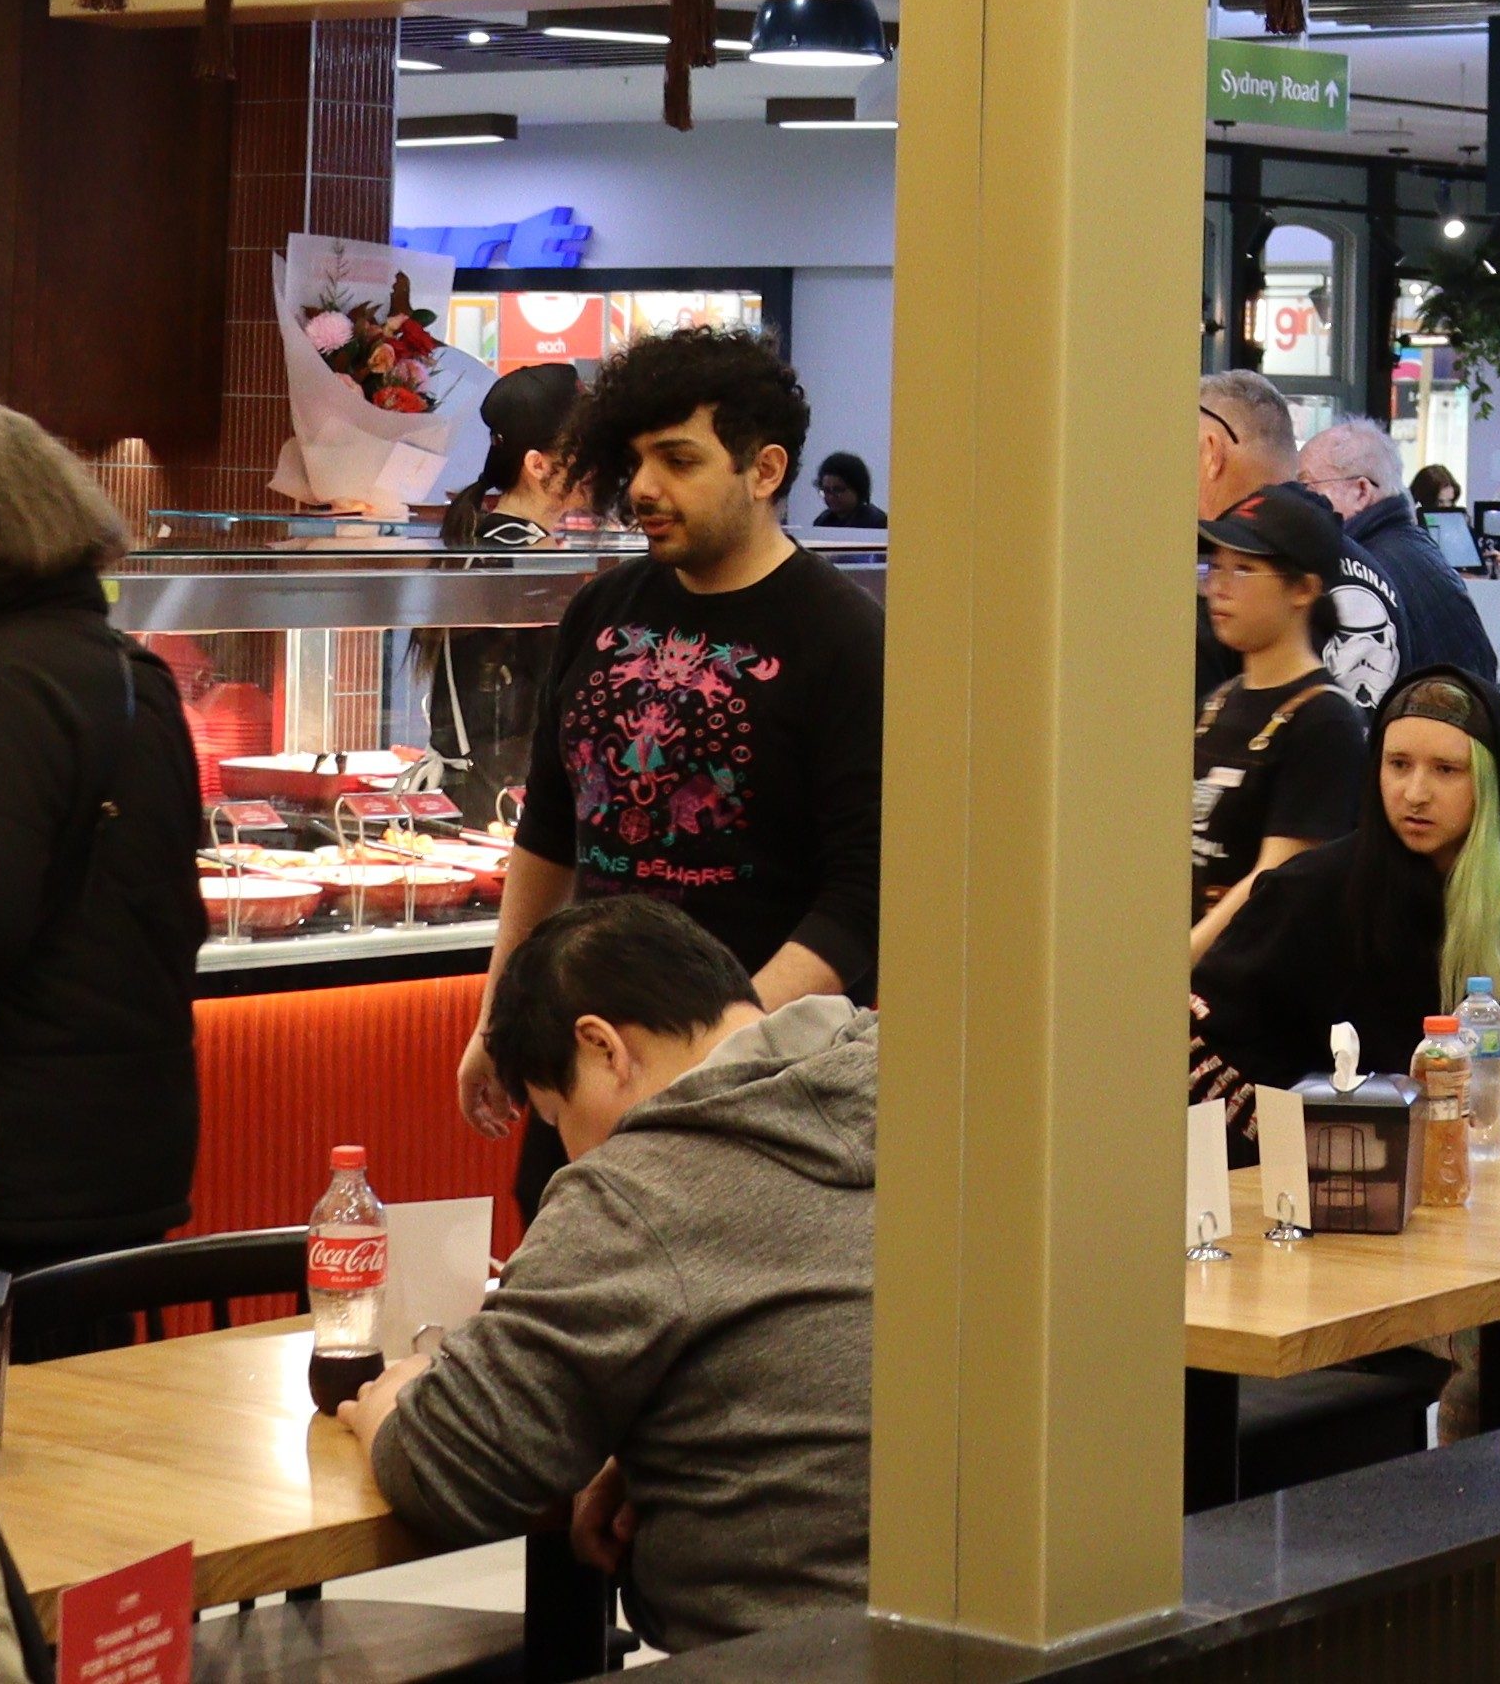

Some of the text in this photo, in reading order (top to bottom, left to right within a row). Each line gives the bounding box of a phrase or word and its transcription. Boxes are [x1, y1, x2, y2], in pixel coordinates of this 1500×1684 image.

[1221, 68, 1320, 104] Sydney Road
[536, 338, 566, 354] each
[636, 858, 736, 887] BEWARE
[309, 1239, 385, 1274] Coca-Cola
